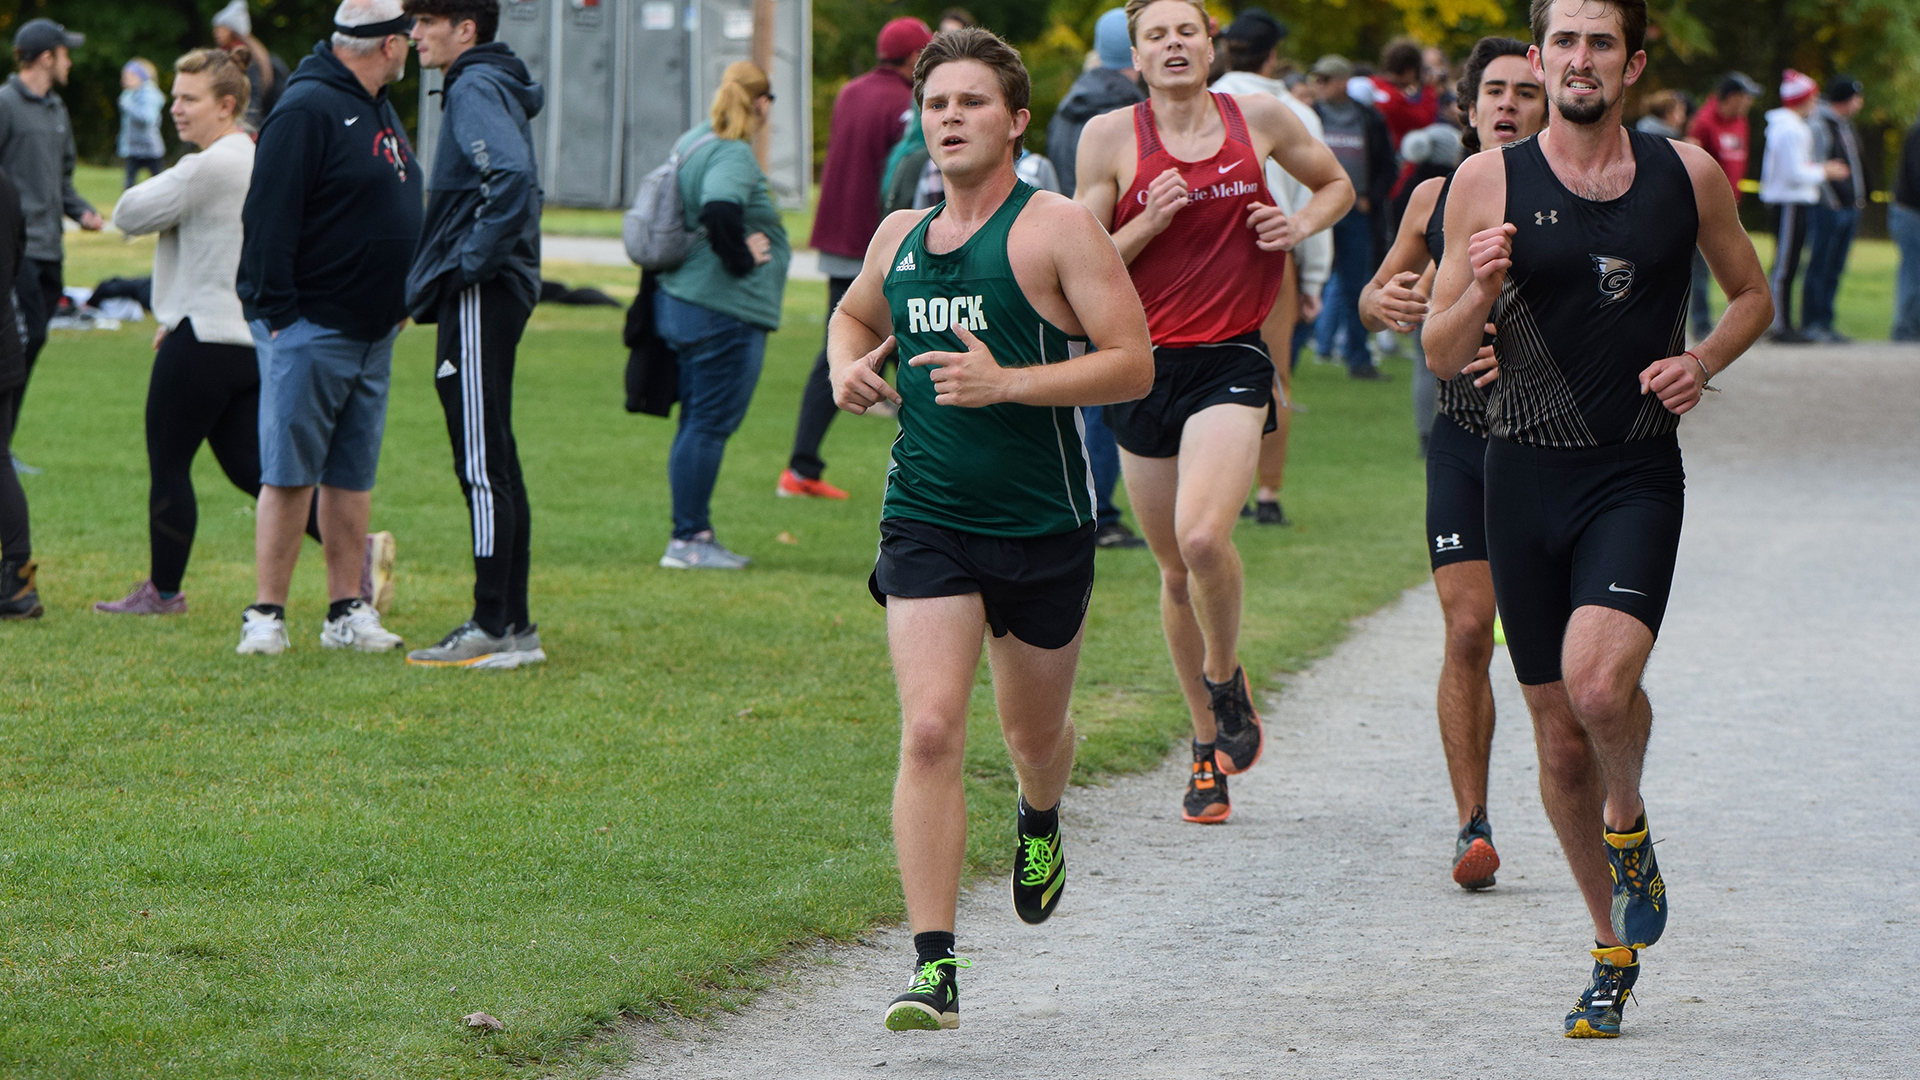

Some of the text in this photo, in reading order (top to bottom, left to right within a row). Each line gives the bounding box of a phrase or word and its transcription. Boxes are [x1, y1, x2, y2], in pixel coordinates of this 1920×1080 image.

[1136, 180, 1258, 206] Cgie Mellon
[895, 263, 916, 272] adidas
[907, 295, 988, 334] ROCK
